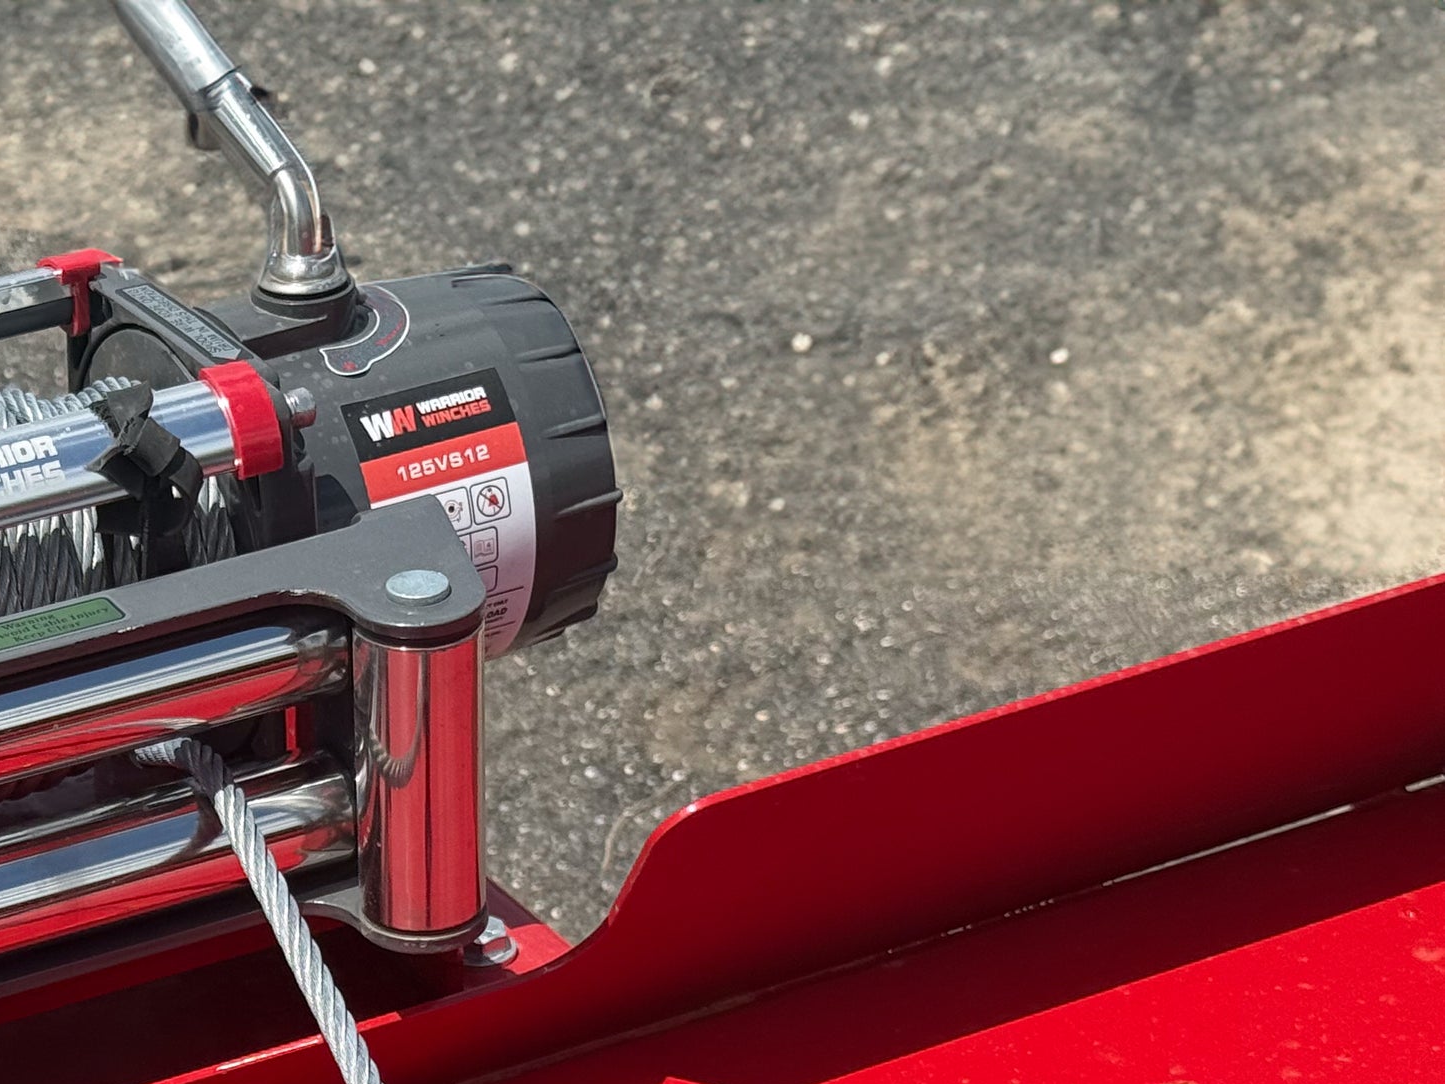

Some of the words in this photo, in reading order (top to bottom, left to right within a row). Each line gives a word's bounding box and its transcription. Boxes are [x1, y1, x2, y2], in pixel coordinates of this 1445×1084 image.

[416, 386, 486, 415] WARRIOR
[421, 399, 491, 427] WINCHES
[397, 444, 490, 482] 125VS12
[0, 614, 56, 630] Warning
